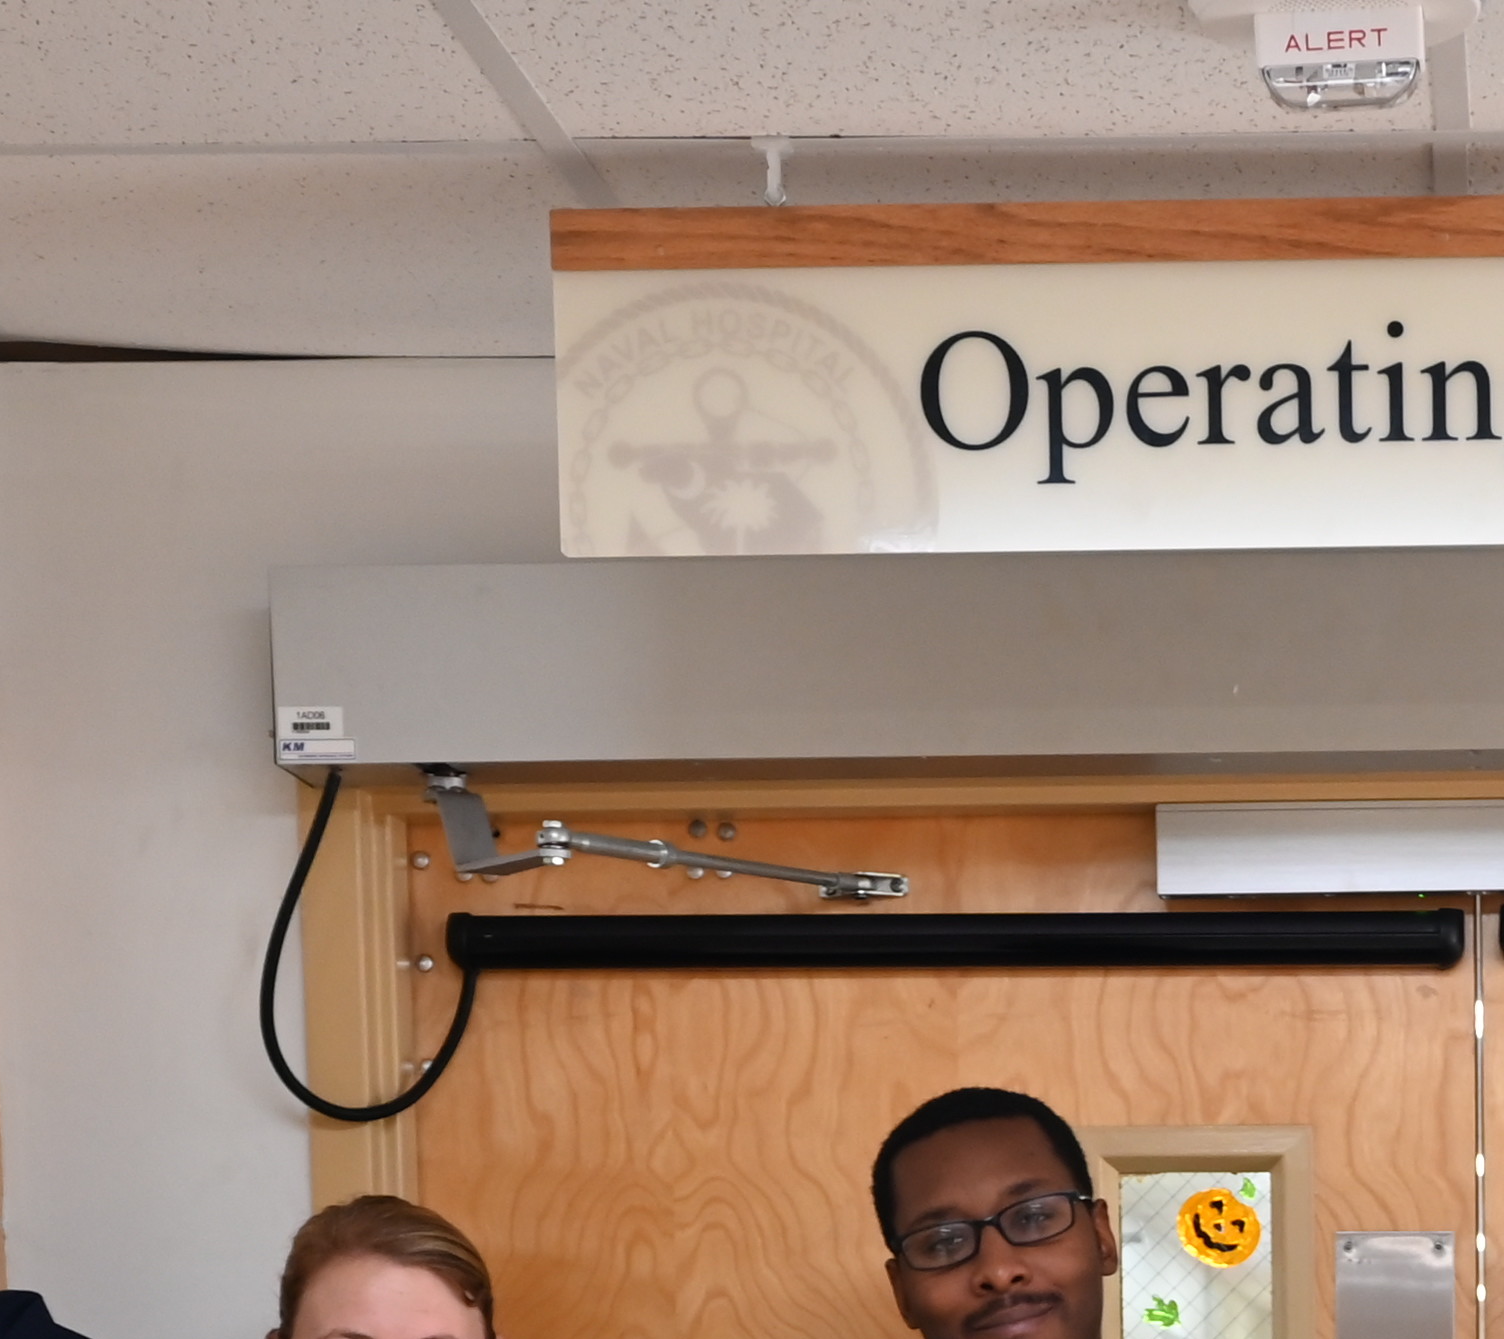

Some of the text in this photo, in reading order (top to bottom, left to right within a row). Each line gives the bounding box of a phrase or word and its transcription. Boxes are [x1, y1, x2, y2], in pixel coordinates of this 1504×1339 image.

[1285, 28, 1388, 53] ALERT
[573, 308, 856, 399] NAVAL HOSPITAL
